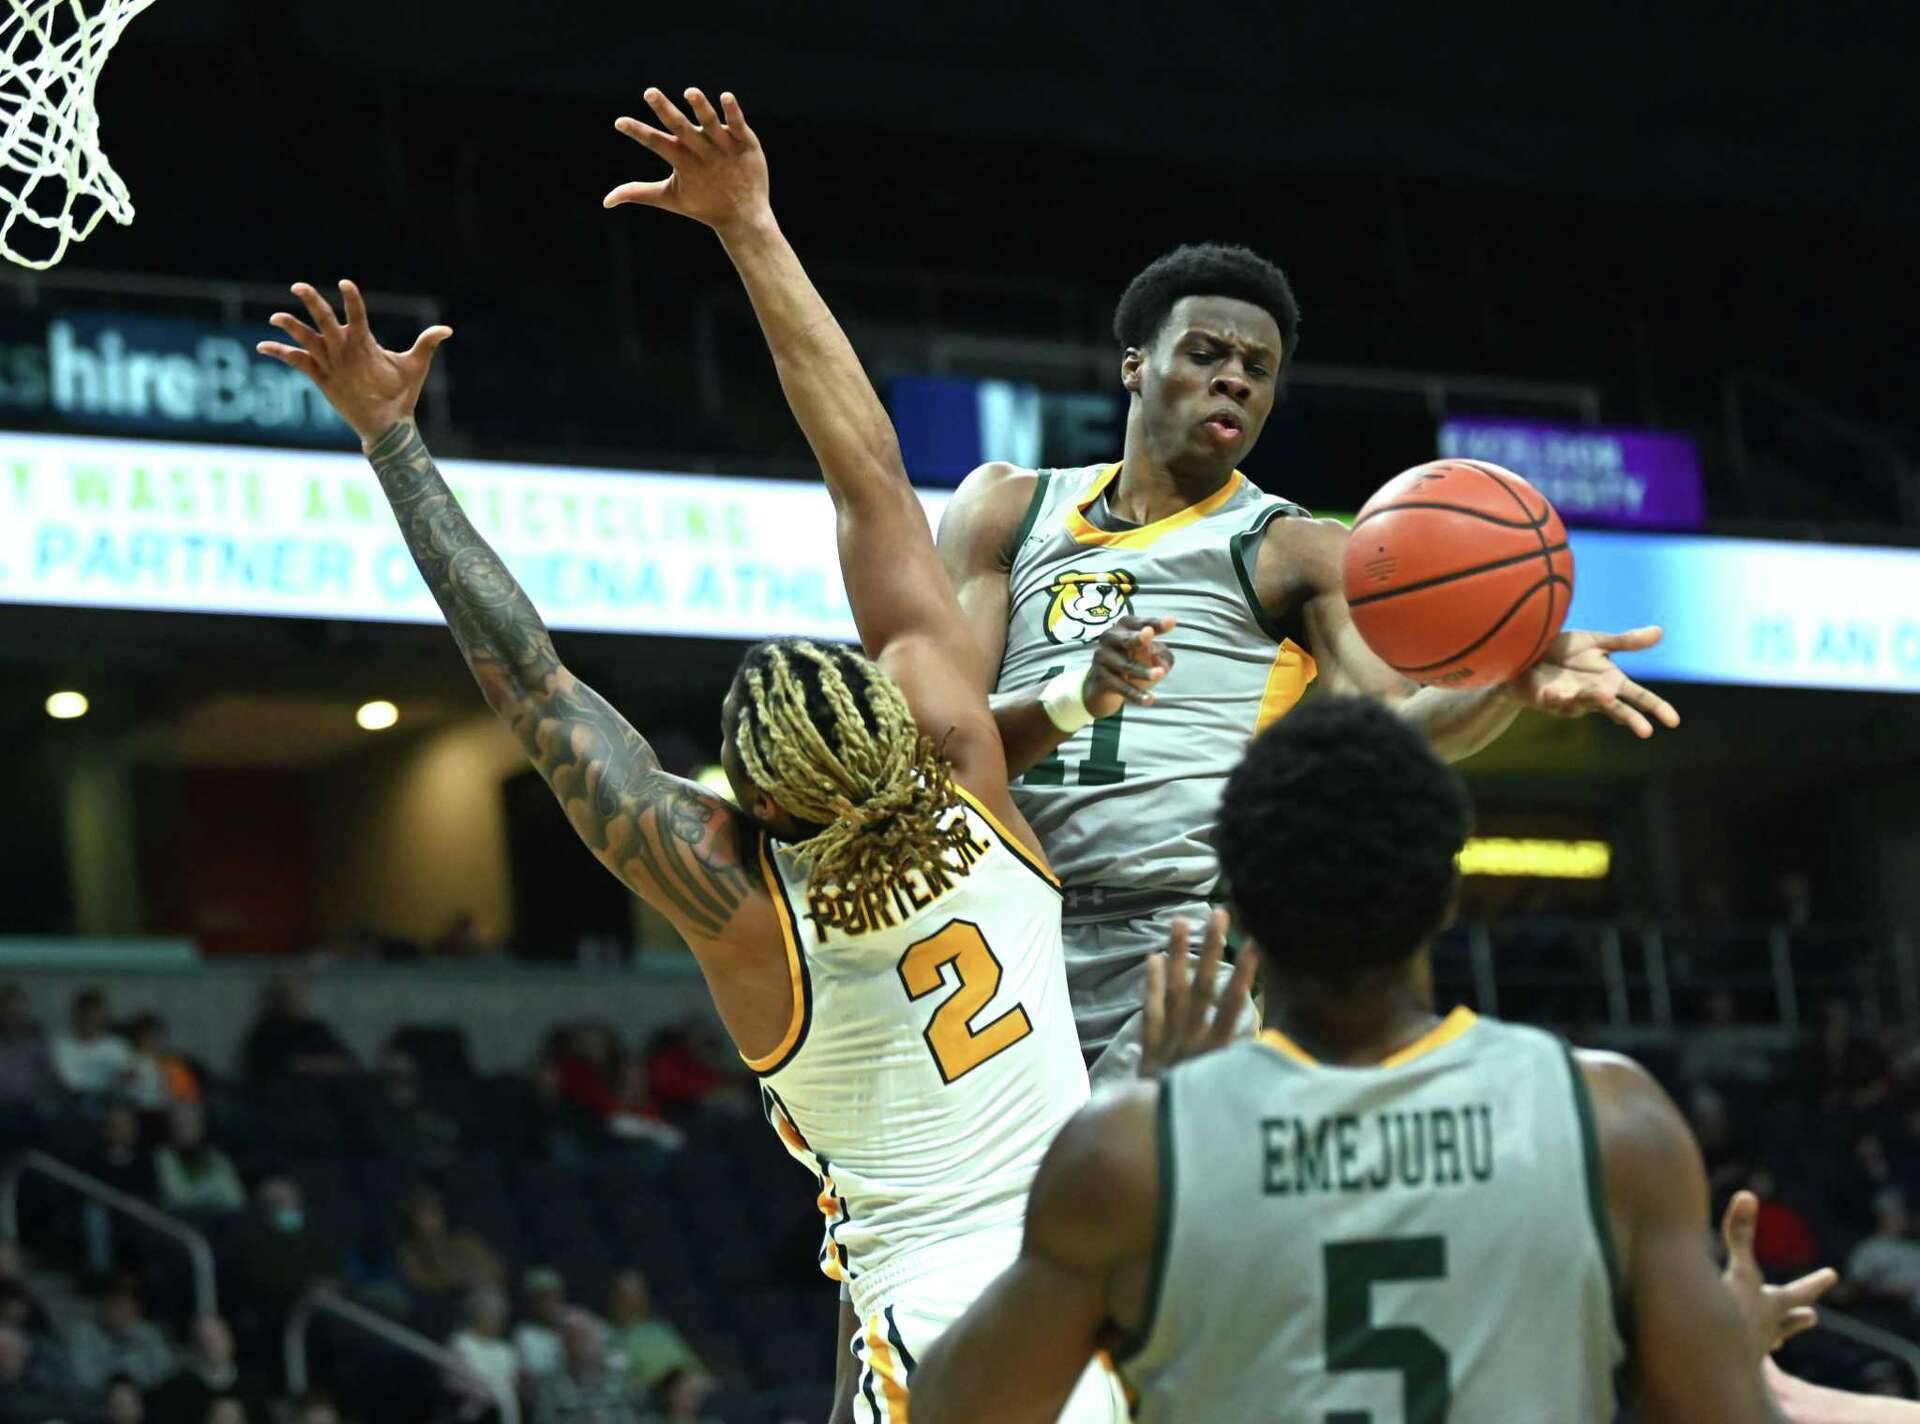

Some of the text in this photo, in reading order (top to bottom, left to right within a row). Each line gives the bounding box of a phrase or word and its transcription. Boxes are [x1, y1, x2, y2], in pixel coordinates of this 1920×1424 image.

[304, 475, 386, 524] AN
[34, 521, 356, 595] PARTNER
[896, 917, 1033, 1085] 2
[1261, 1104, 1494, 1196] EMEJURU
[1322, 1234, 1450, 1424] 5
